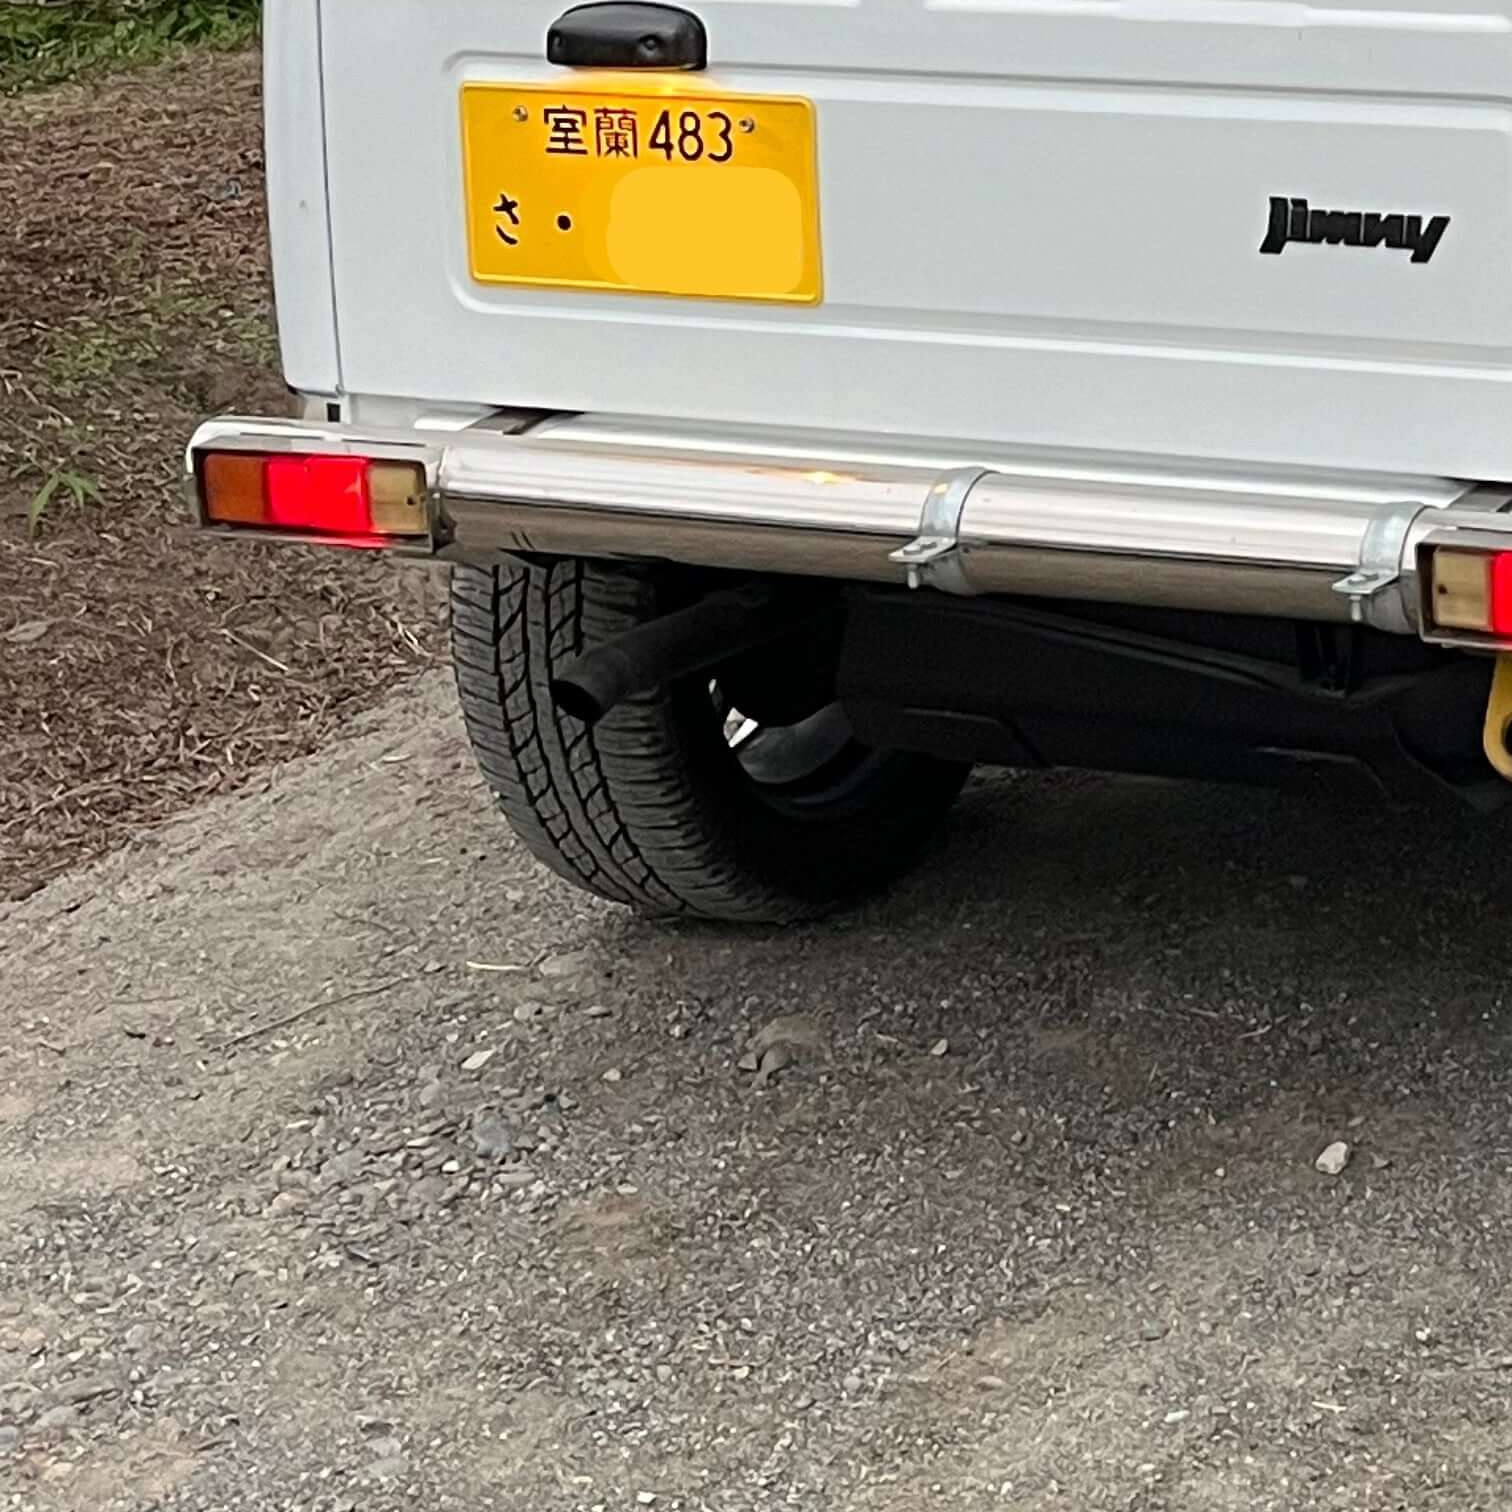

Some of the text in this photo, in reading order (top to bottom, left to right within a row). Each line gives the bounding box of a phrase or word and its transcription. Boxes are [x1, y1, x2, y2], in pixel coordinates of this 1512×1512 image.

[543, 105, 733, 162] 室蘭 483
[493, 193, 520, 245] さ
[1259, 196, 1451, 264] Jimny
